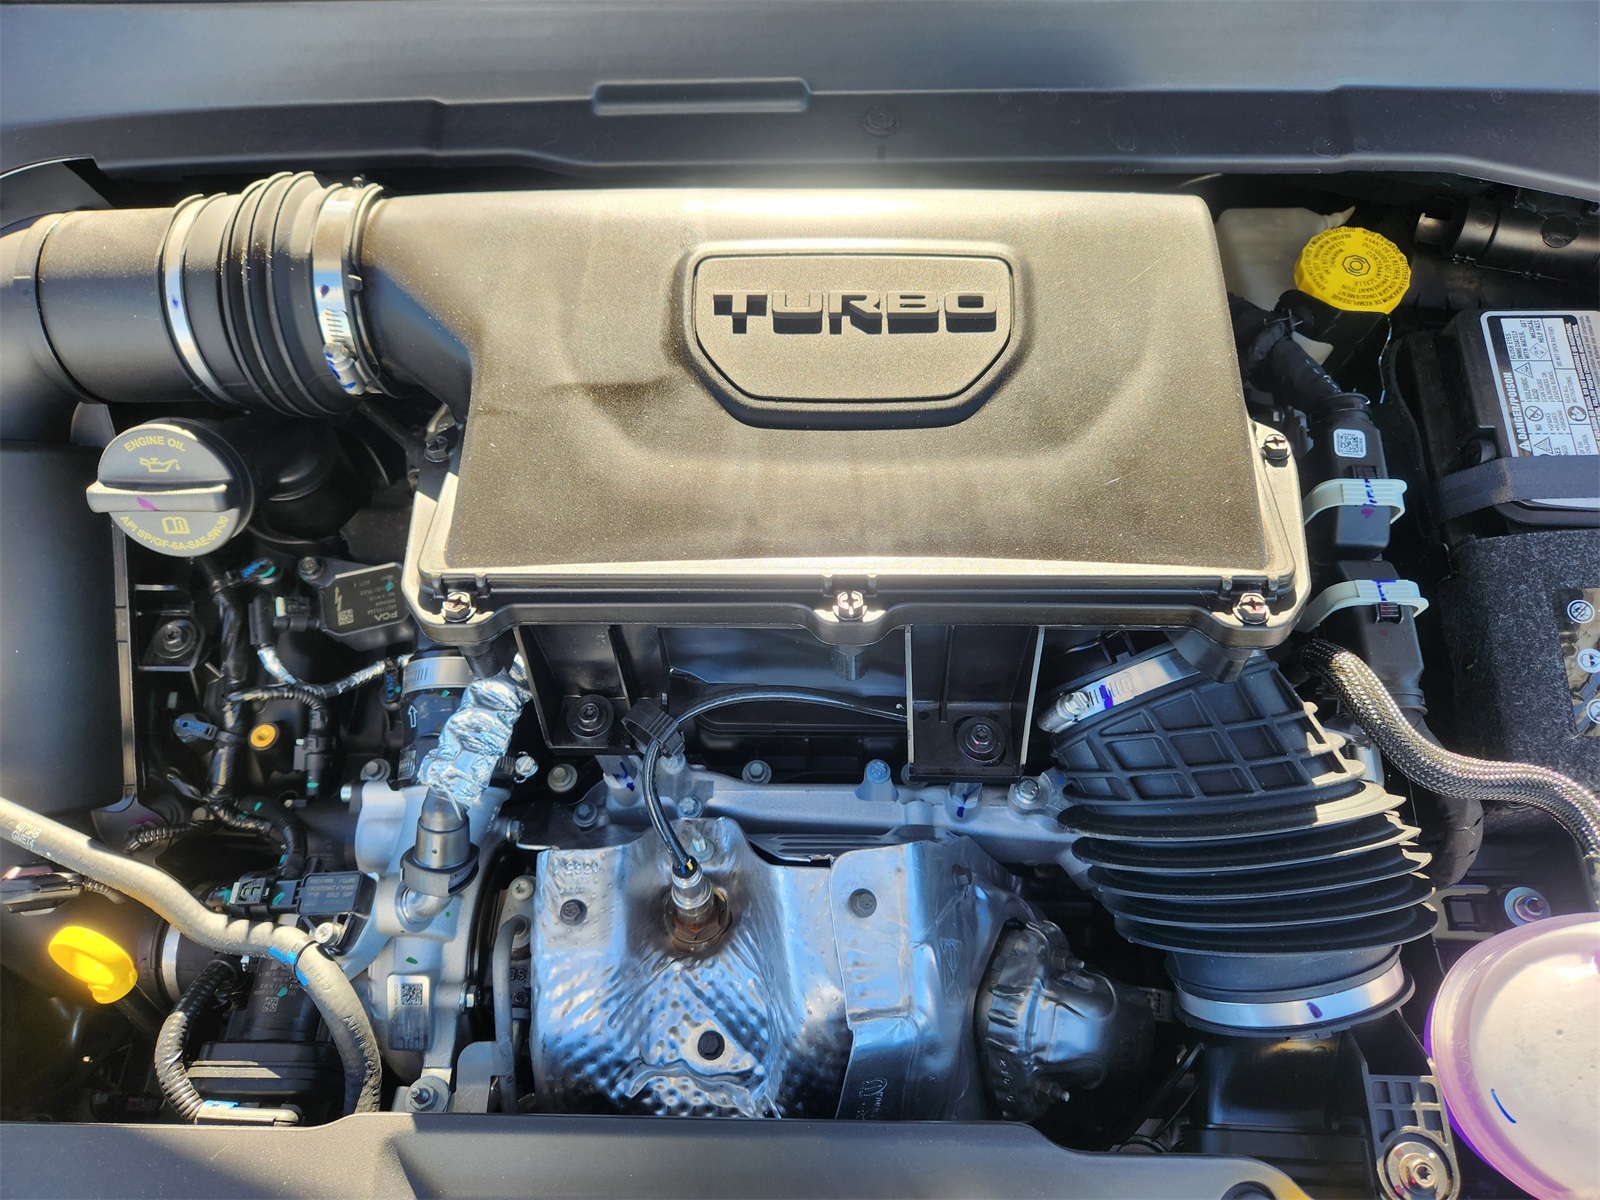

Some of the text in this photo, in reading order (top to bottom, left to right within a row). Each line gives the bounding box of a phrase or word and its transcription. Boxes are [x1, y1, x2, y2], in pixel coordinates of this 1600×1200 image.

[713, 291, 997, 334] TURBO
[1526, 320, 1536, 337] MEDICAL
[1536, 331, 1544, 342] HELP
[1505, 333, 1516, 358] FLUSH EYES
[1511, 330, 1523, 358] IMMEDIATELY
[1522, 348, 1530, 358] WITH
[1520, 377, 1531, 399] SULFURIC
[1536, 378, 1544, 390] CAUSE
[1531, 389, 1539, 398] ACID
[1502, 372, 1527, 439] DANGER/POISON
[124, 435, 187, 452] ENGINE OIL
[120, 516, 138, 532] API
[372, 611, 399, 623] FCA
